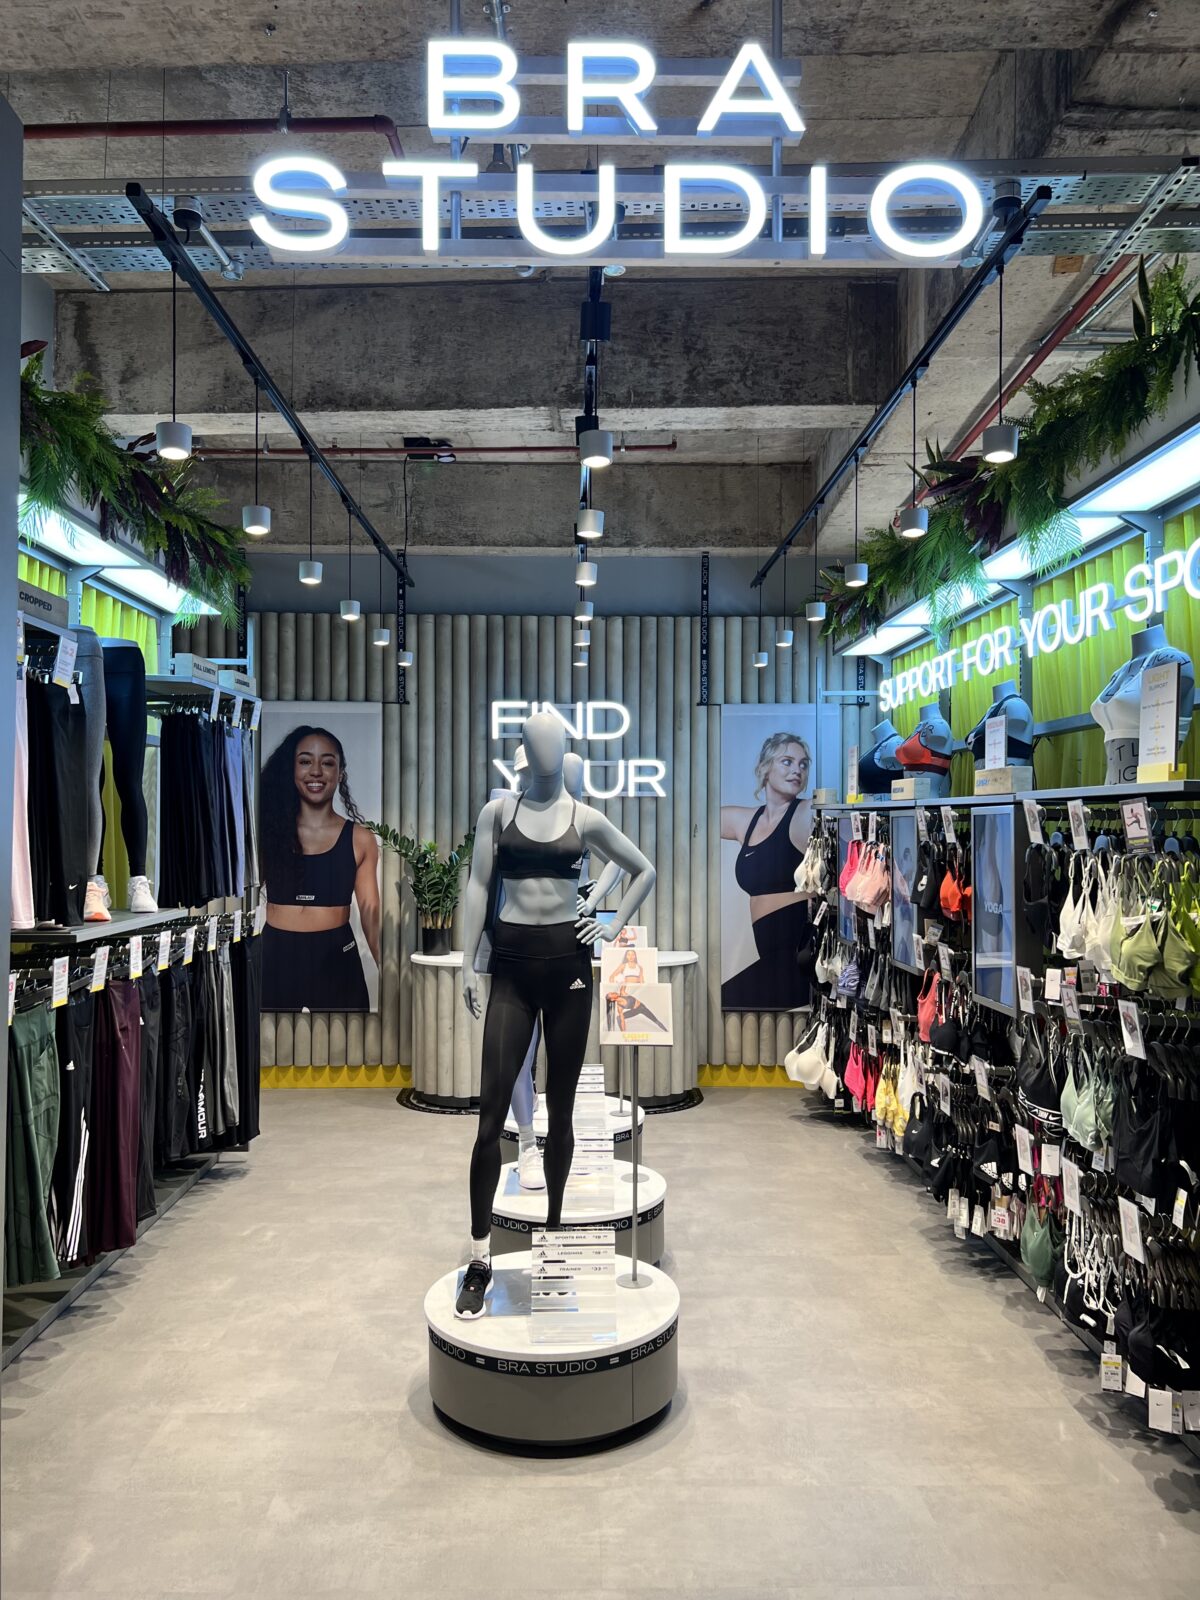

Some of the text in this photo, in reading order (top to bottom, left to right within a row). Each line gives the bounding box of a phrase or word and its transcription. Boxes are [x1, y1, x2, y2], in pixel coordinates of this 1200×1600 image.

[427, 40, 806, 135] BRA
[250, 156, 985, 257] STUDIO
[19, 591, 52, 612] CROPPED
[879, 647, 959, 712] SUPPORT
[961, 625, 1015, 682] FOR
[1020, 582, 1113, 658] YOUR
[193, 662, 216, 676] FULL LENGTH
[492, 759, 667, 799] YUR
[984, 900, 1003, 914] YOGA
[62, 963, 67, 973] 3
[615, 1133, 630, 1142] BRA
[492, 1215, 529, 1232] STUDIO
[631, 1342, 655, 1361] BRA
[497, 1359, 598, 1375] BRA STUDIO
